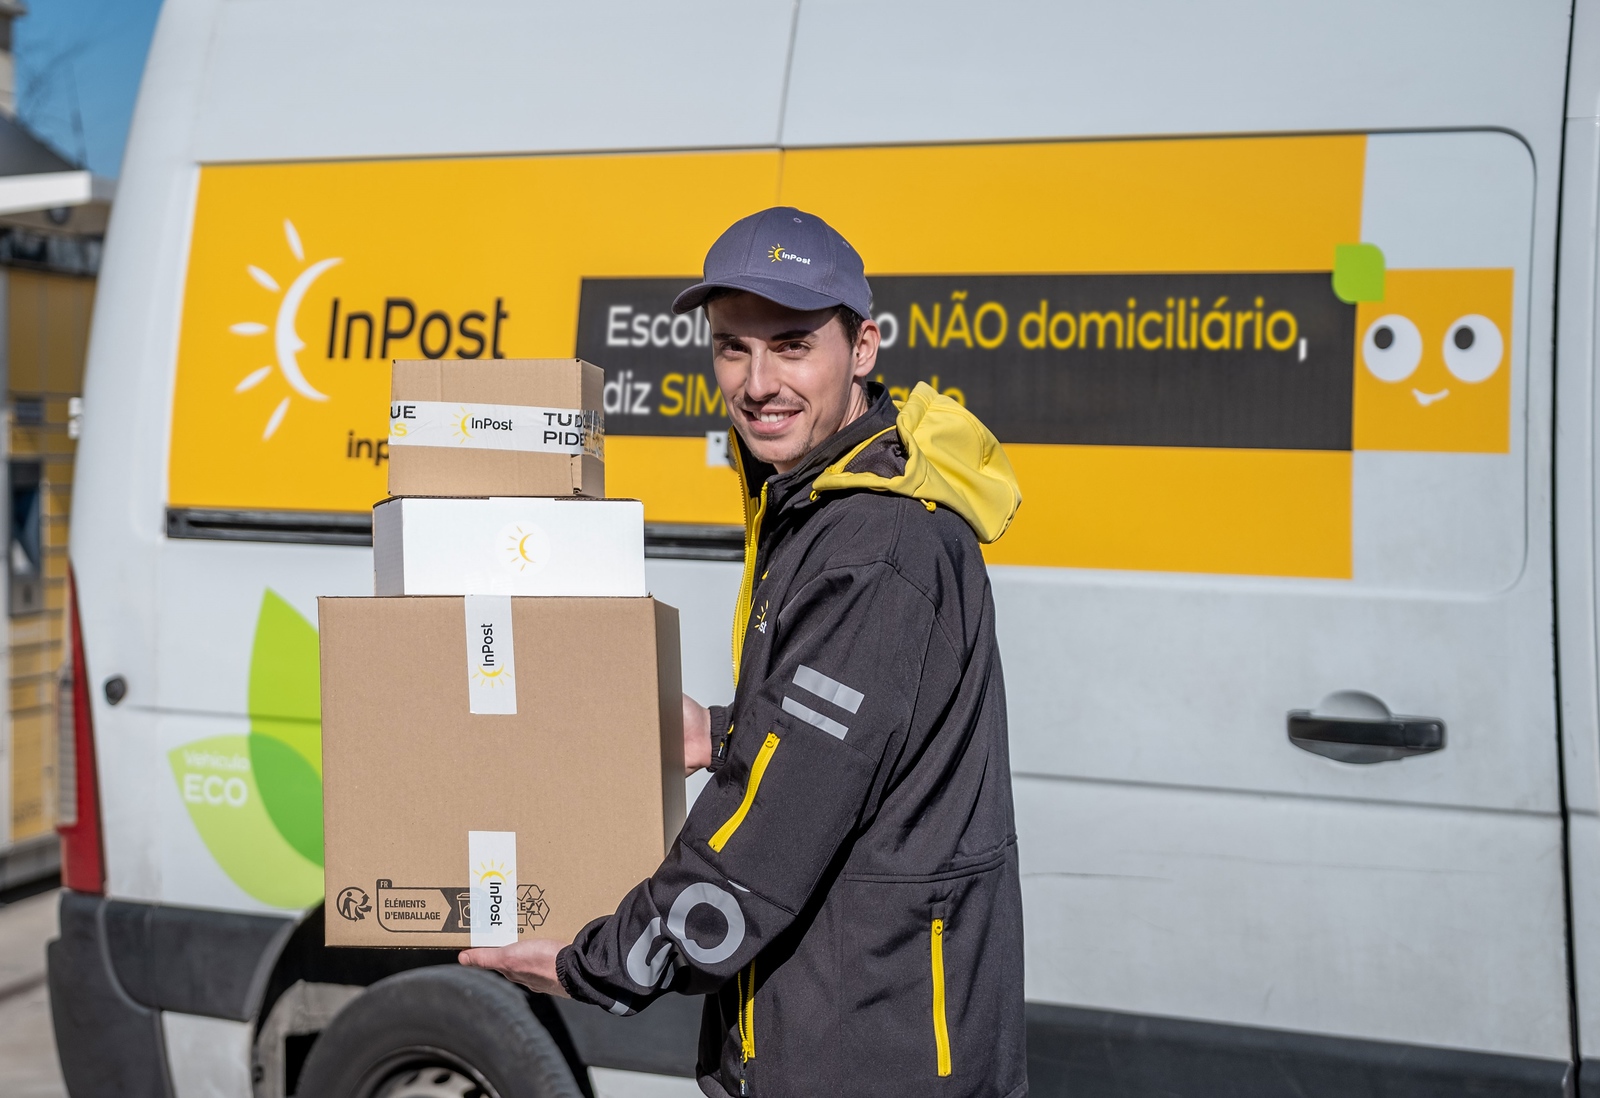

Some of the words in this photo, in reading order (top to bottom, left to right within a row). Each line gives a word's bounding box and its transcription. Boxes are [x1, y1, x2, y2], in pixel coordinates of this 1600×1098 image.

[781, 251, 811, 265] InPost
[327, 297, 509, 359] InPost
[908, 290, 1009, 349] NÃO
[1018, 296, 1308, 362] domiciliário,
[603, 370, 652, 414] diz
[658, 372, 728, 417] SIM
[471, 417, 513, 431] InPost
[480, 623, 495, 666] InPost
[184, 773, 248, 808] ECO
[384, 898, 426, 909] ÉLÉMENTS
[384, 911, 441, 920] D'EMBALLAGE
[489, 882, 503, 926] InPost
